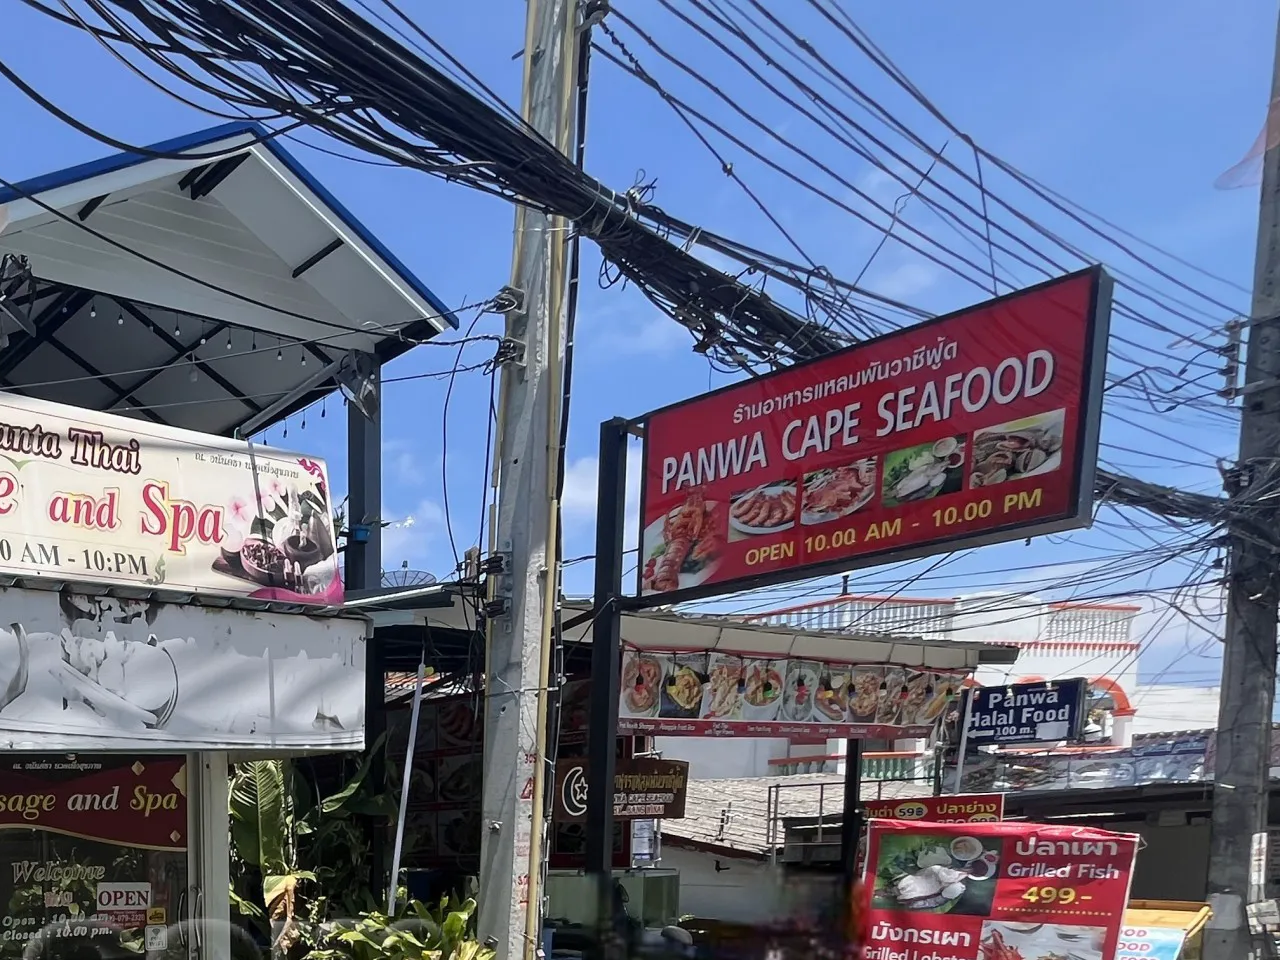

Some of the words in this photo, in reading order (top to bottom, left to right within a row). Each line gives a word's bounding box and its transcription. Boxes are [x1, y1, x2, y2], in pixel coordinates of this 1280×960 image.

[661, 430, 768, 494] PANWA
[782, 401, 862, 461] CAPE
[876, 349, 1055, 438] SEAFOOD
[68, 428, 141, 474] Thai
[48, 488, 120, 530] and
[140, 482, 225, 552] Spa
[744, 541, 794, 566] OPEN
[804, 530, 856, 554] 10.00
[864, 518, 902, 541] AM
[931, 499, 993, 527] 10.00
[1003, 488, 1043, 513] PM
[20, 543, 61, 566] AM
[83, 549, 149, 575] 10:PM
[988, 691, 1059, 709] Panwa
[970, 709, 1015, 727] Halal
[1021, 704, 1070, 723] Food
[995, 726, 1016, 736] 100
[67, 786, 119, 811] and
[129, 785, 178, 817] Spa
[937, 801, 997, 814] ปลาย่าง
[1015, 836, 1118, 856] ปลาเผา
[11, 860, 106, 884] Welcome
[1007, 862, 1072, 878] Grilled
[1077, 864, 1120, 879] Fish
[98, 889, 150, 907] OPEN
[2, 915, 37, 928] Open
[2, 929, 42, 942] Closed
[55, 927, 88, 938] 10.00
[871, 921, 971, 947] มังกรเผา
